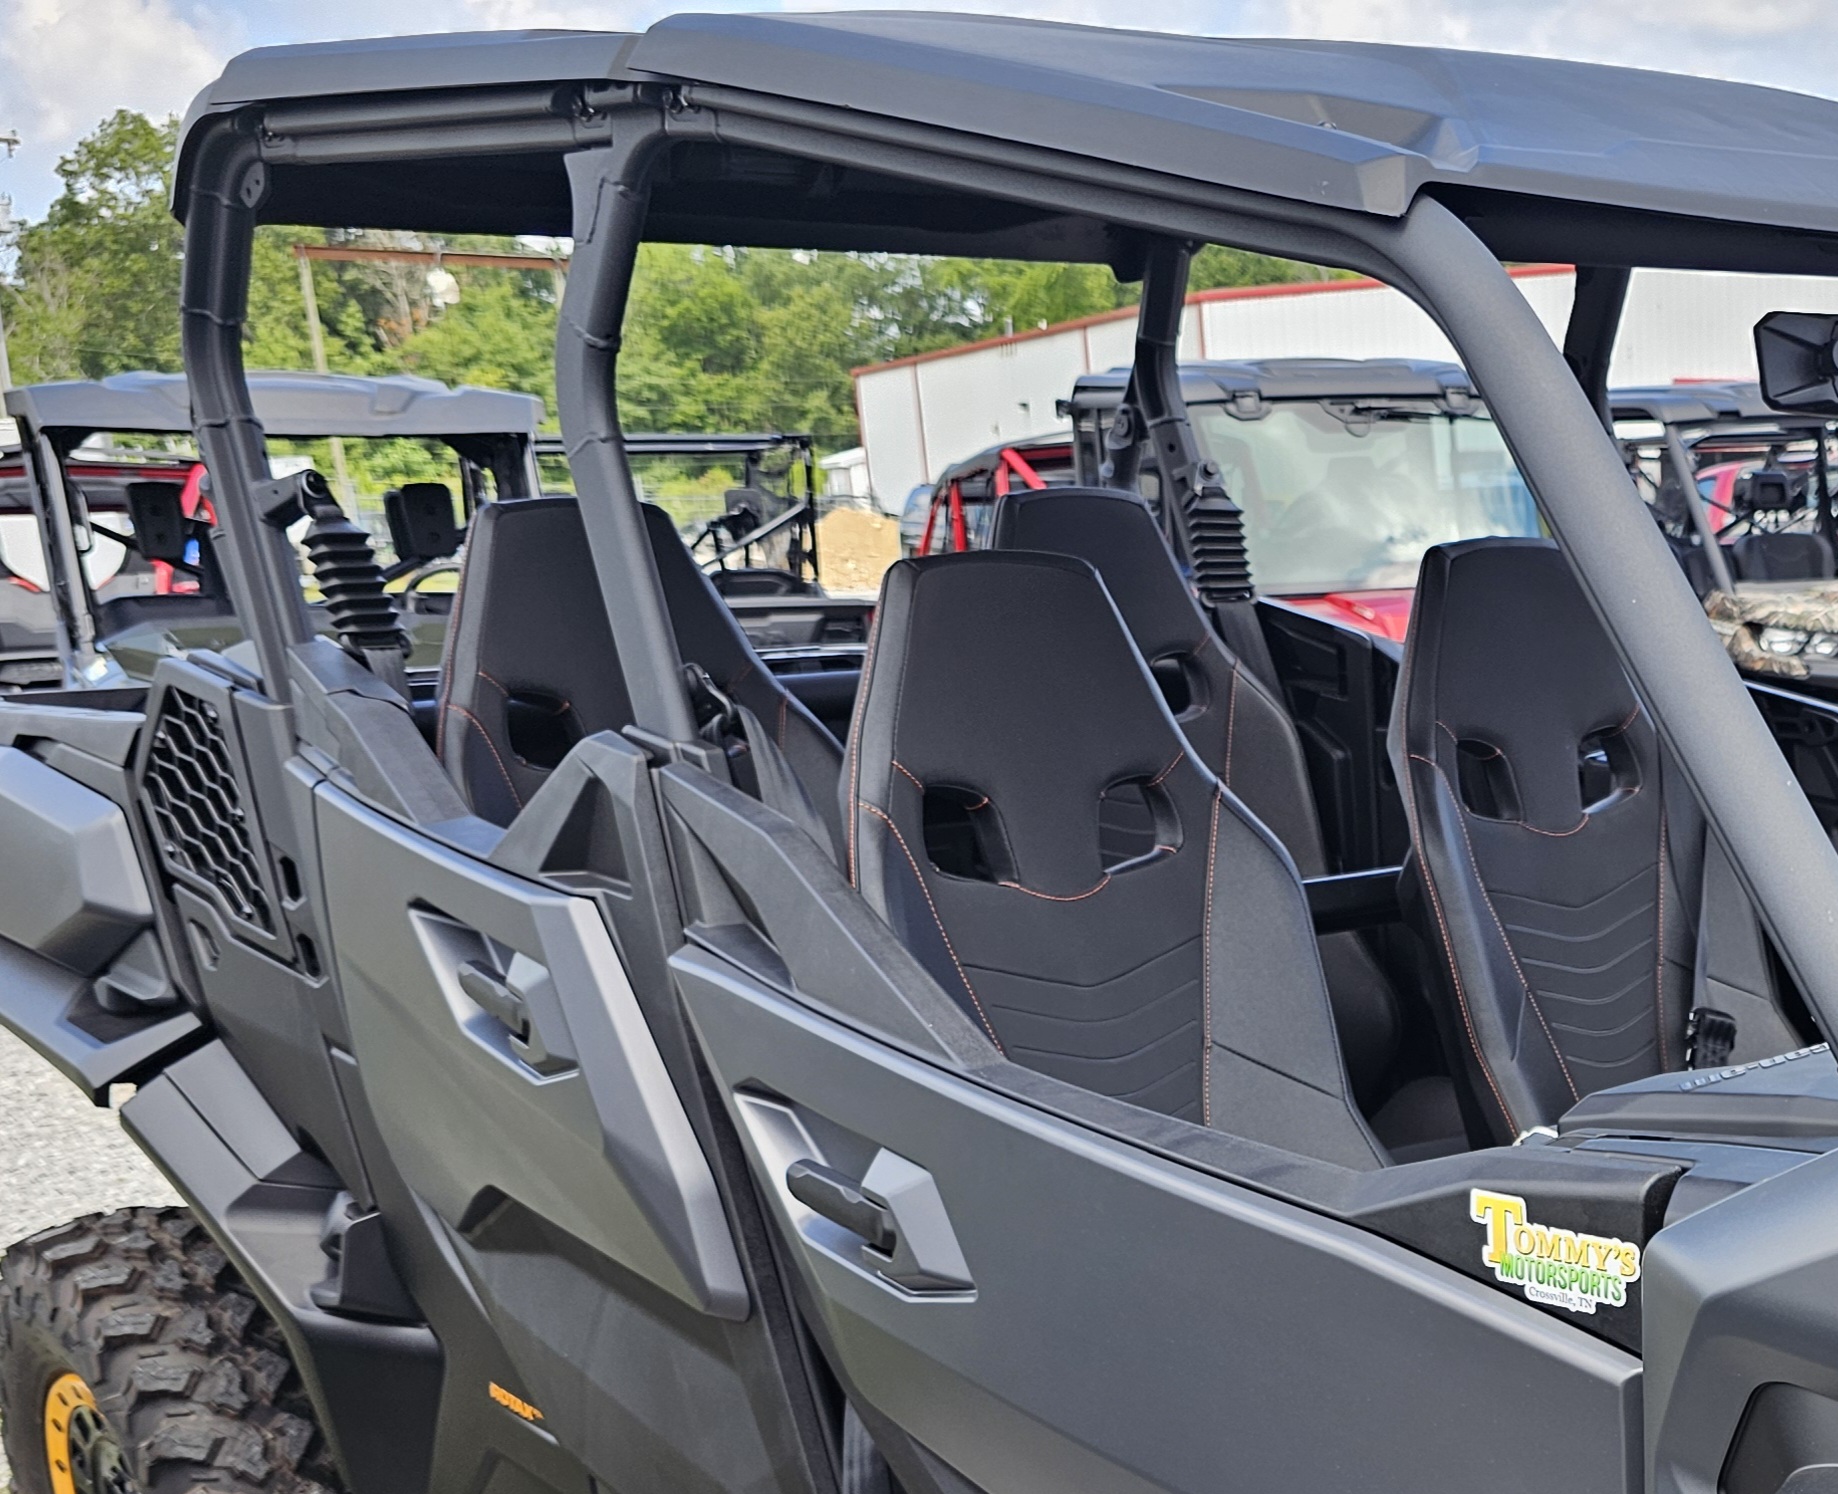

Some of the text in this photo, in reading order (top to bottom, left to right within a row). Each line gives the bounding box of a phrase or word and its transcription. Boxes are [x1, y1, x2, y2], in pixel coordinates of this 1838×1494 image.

[1500, 1253, 1622, 1302] MOTORSPORTS
[1528, 1286, 1594, 1310] Crossville, TN
